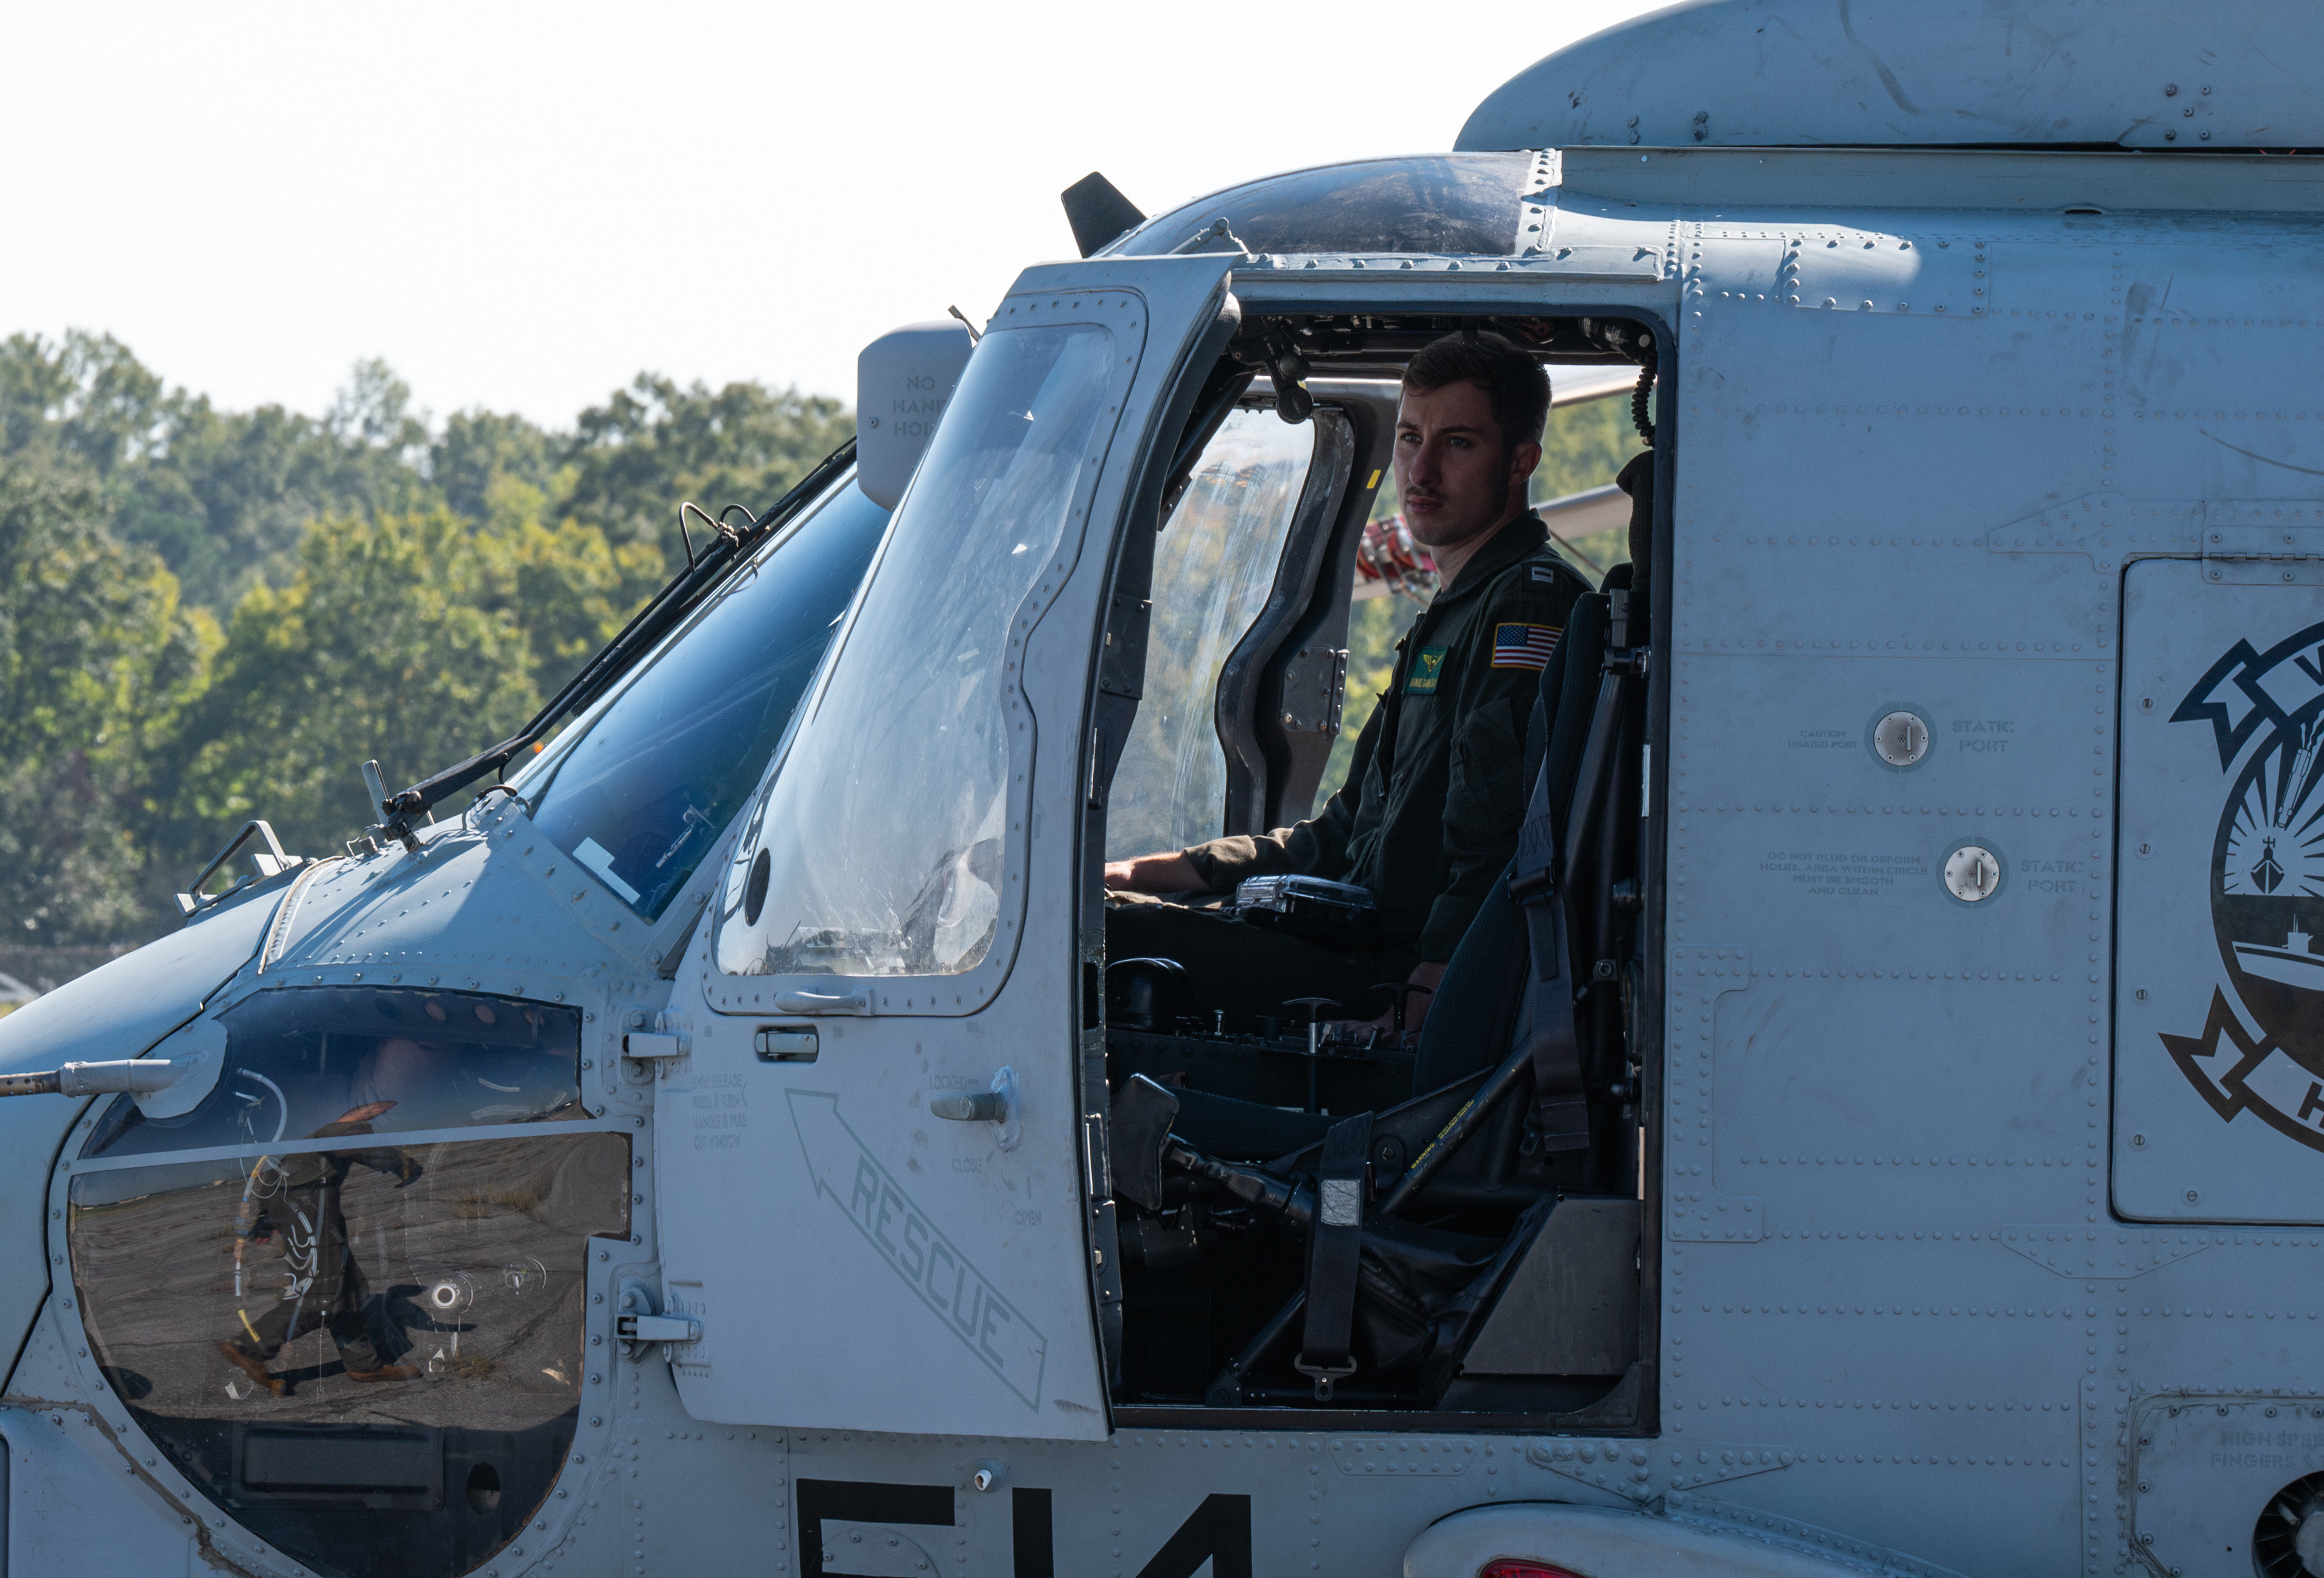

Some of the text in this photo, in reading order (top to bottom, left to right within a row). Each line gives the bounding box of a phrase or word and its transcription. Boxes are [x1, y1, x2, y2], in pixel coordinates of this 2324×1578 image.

[906, 375, 936, 391] NO
[894, 421, 931, 437] HOL
[1952, 720, 2015, 733] STATIC
[1959, 739, 2008, 752] PORT
[1768, 851, 1787, 861] DO
[1789, 853, 1813, 861] NOT
[1805, 864, 1838, 873] AREA
[1841, 865, 1884, 875] WITHIN
[1886, 867, 1928, 876] CIRCLE
[2021, 860, 2084, 873] STATIC
[1793, 875, 1824, 883] MUST
[1844, 876, 1894, 885] SMOOTH
[2027, 879, 2077, 893] PORT
[1808, 886, 1878, 896] AND CLEAN
[929, 1075, 967, 1091] LOCKED
[952, 1157, 982, 1173] CLOSE
[1014, 1210, 1042, 1227] OPEN
[851, 1154, 1010, 1368] RESCUE
[2221, 1431, 2272, 1447] HIGH
[2210, 1452, 2294, 1468] FINGERS
